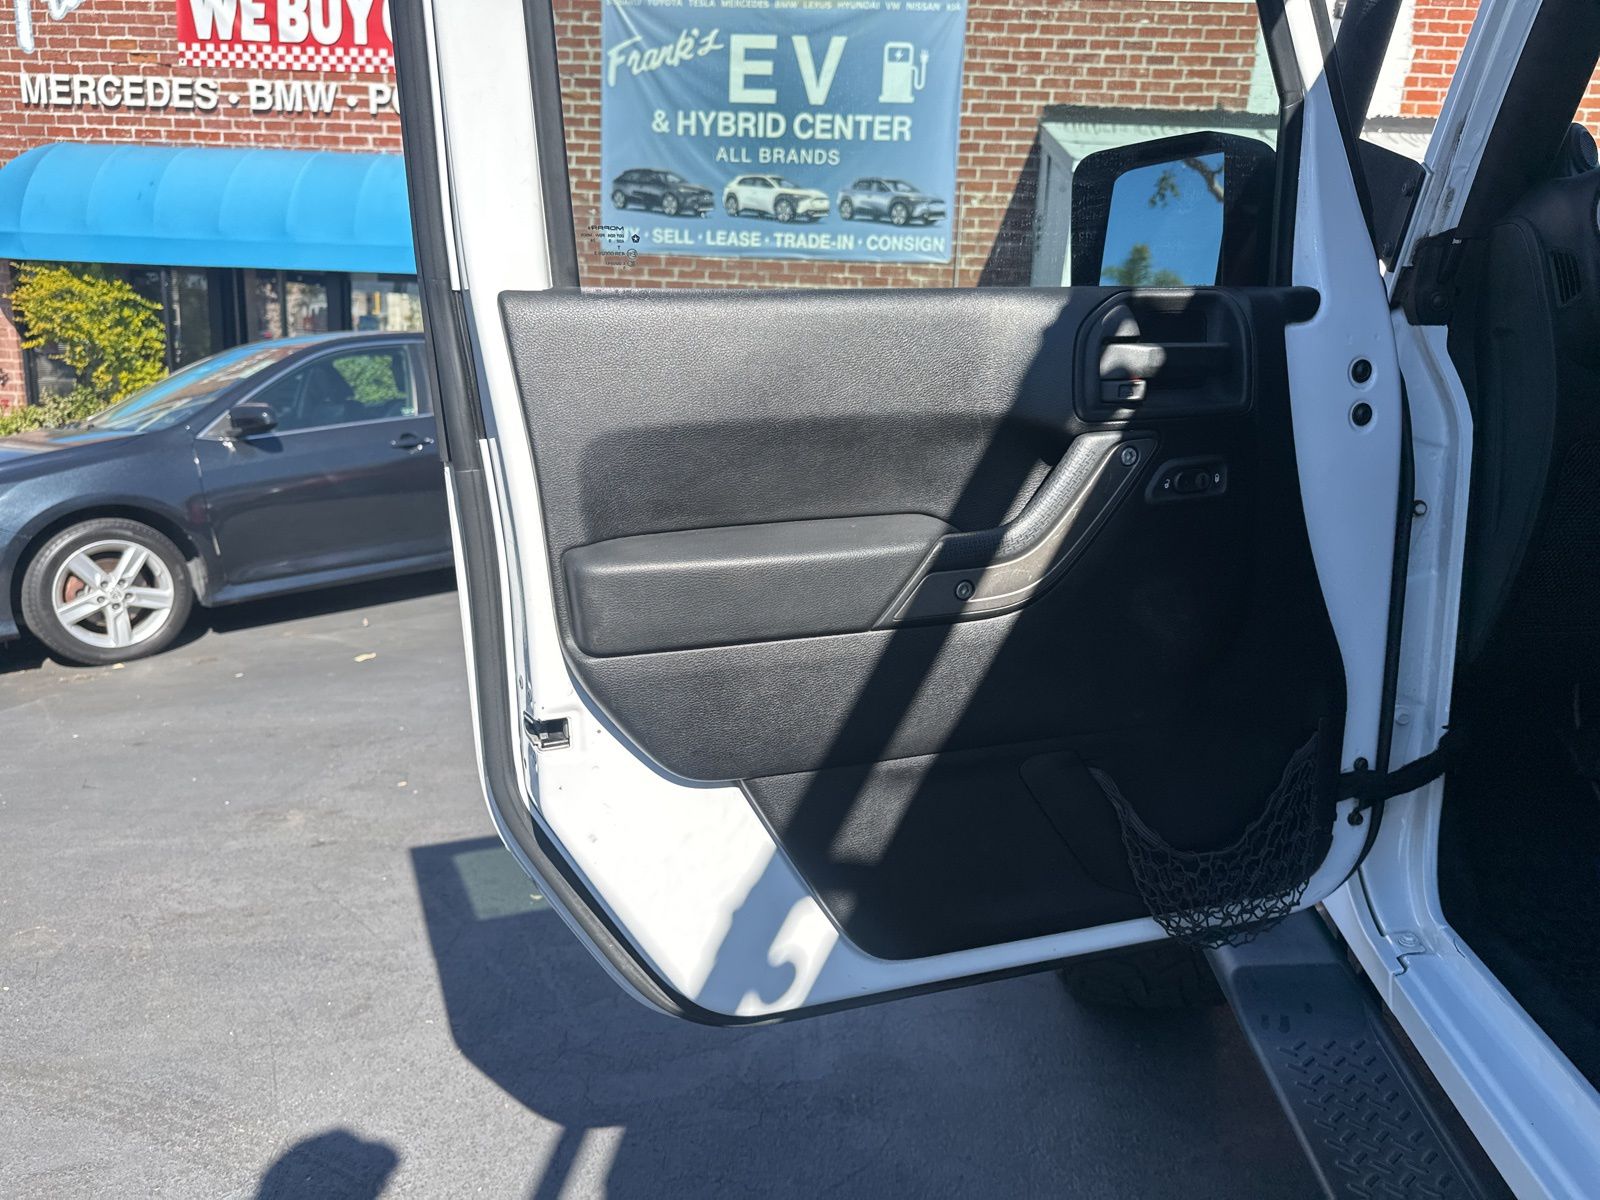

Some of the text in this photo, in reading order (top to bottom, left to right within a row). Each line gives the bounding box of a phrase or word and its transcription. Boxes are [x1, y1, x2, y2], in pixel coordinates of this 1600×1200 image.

[189, 0, 271, 42] WE
[276, 0, 374, 46] BUY
[607, 27, 847, 106] Frank's EV
[19, 73, 219, 111] MERCEDES
[249, 80, 338, 114] BMW
[651, 109, 912, 142] & HYBRID CENTER
[715, 147, 841, 166] ALL BRANDS
[652, 227, 695, 245] SELL
[706, 229, 762, 248] LEASE
[774, 231, 854, 250] TRADE-IN
[866, 235, 945, 251] CONSIGN
